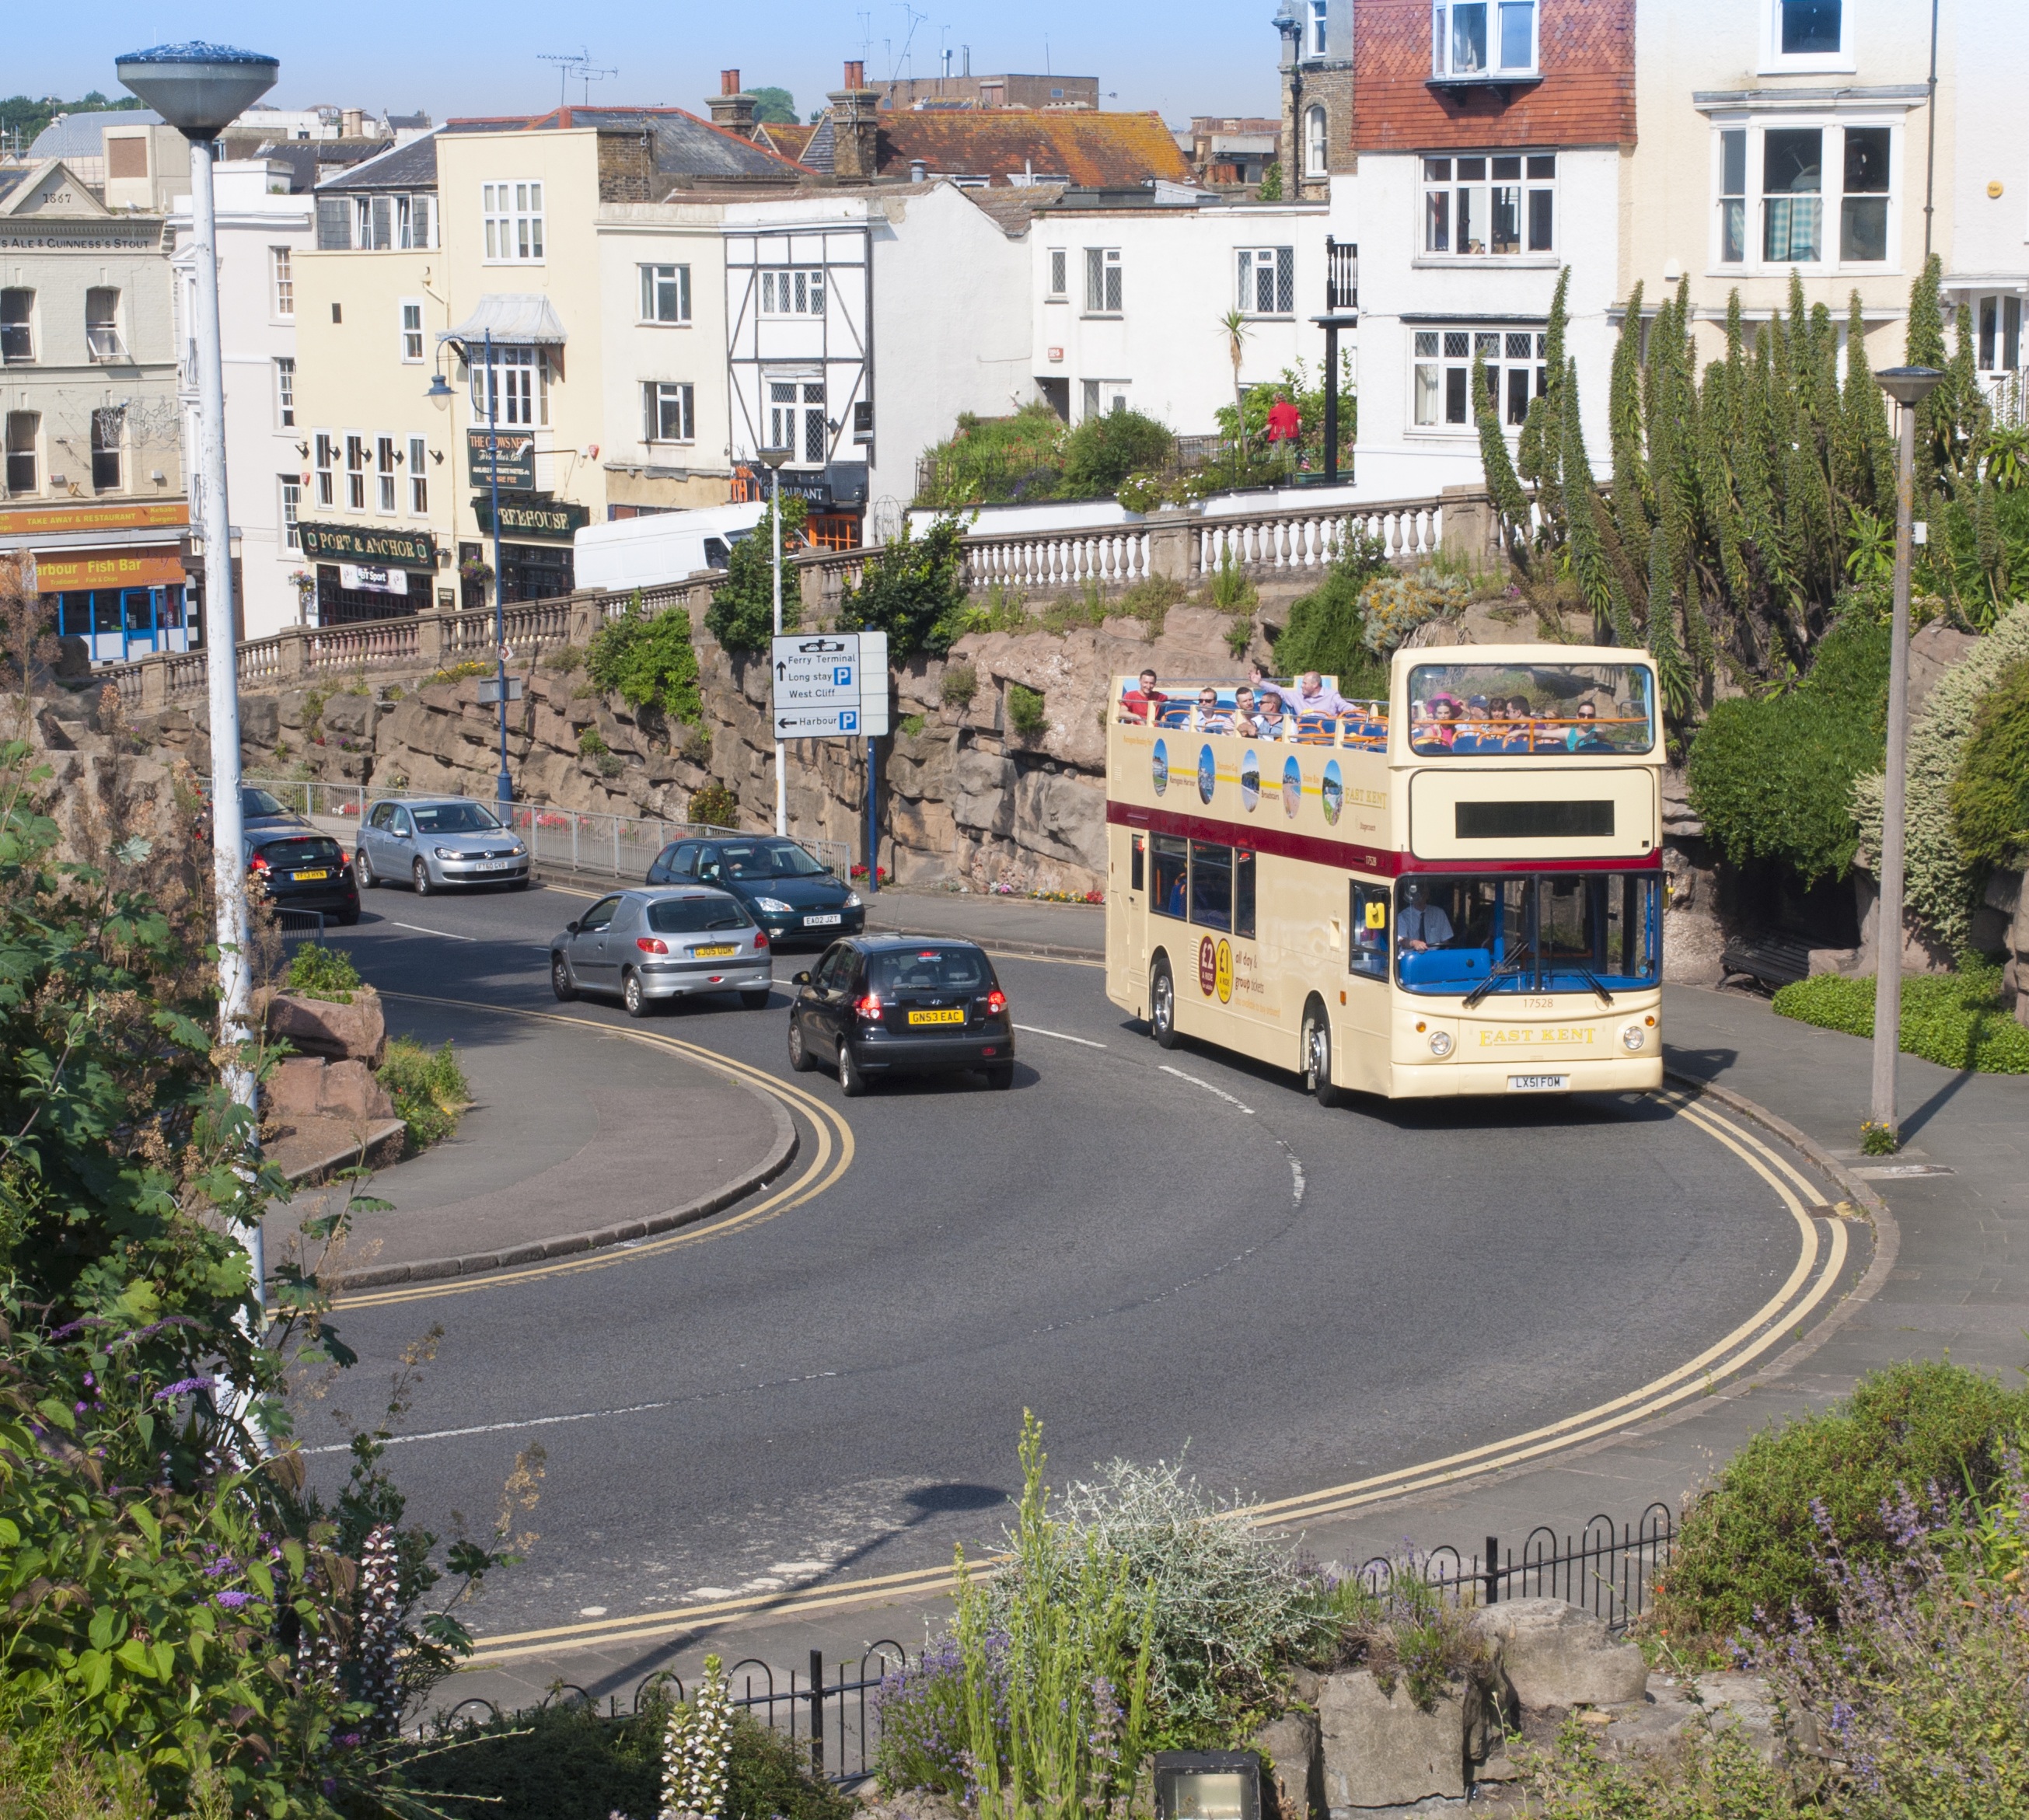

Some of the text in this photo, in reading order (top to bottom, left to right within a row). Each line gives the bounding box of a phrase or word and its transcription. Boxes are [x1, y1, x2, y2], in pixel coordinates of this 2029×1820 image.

[43, 194, 72, 204] 1867
[38, 239, 44, 248] &
[470, 435, 485, 447] THE
[485, 436, 511, 449] COWS
[763, 485, 823, 501] REAURANT
[83, 513, 136, 522] RESTAURANT
[498, 508, 570, 529] REEHOUSE
[319, 533, 415, 558] PORT & ANCHOR
[37, 558, 141, 576] arbour Fish Bar
[788, 654, 856, 665] Ferry Terminal
[788, 673, 810, 682] Long
[813, 672, 832, 681] stay
[789, 688, 835, 698] West Cliff
[799, 717, 837, 725] Harbour
[1344, 787, 1387, 809] EAST KENT
[1202, 942, 1214, 970] £2
[1219, 948, 1228, 974] £1
[1243, 952, 1253, 971] day
[1235, 976, 1264, 994] group tickets
[1523, 998, 1553, 1008] 17528
[913, 1011, 959, 1022] GN53 EAC
[1479, 1028, 1596, 1046] EAST KENT
